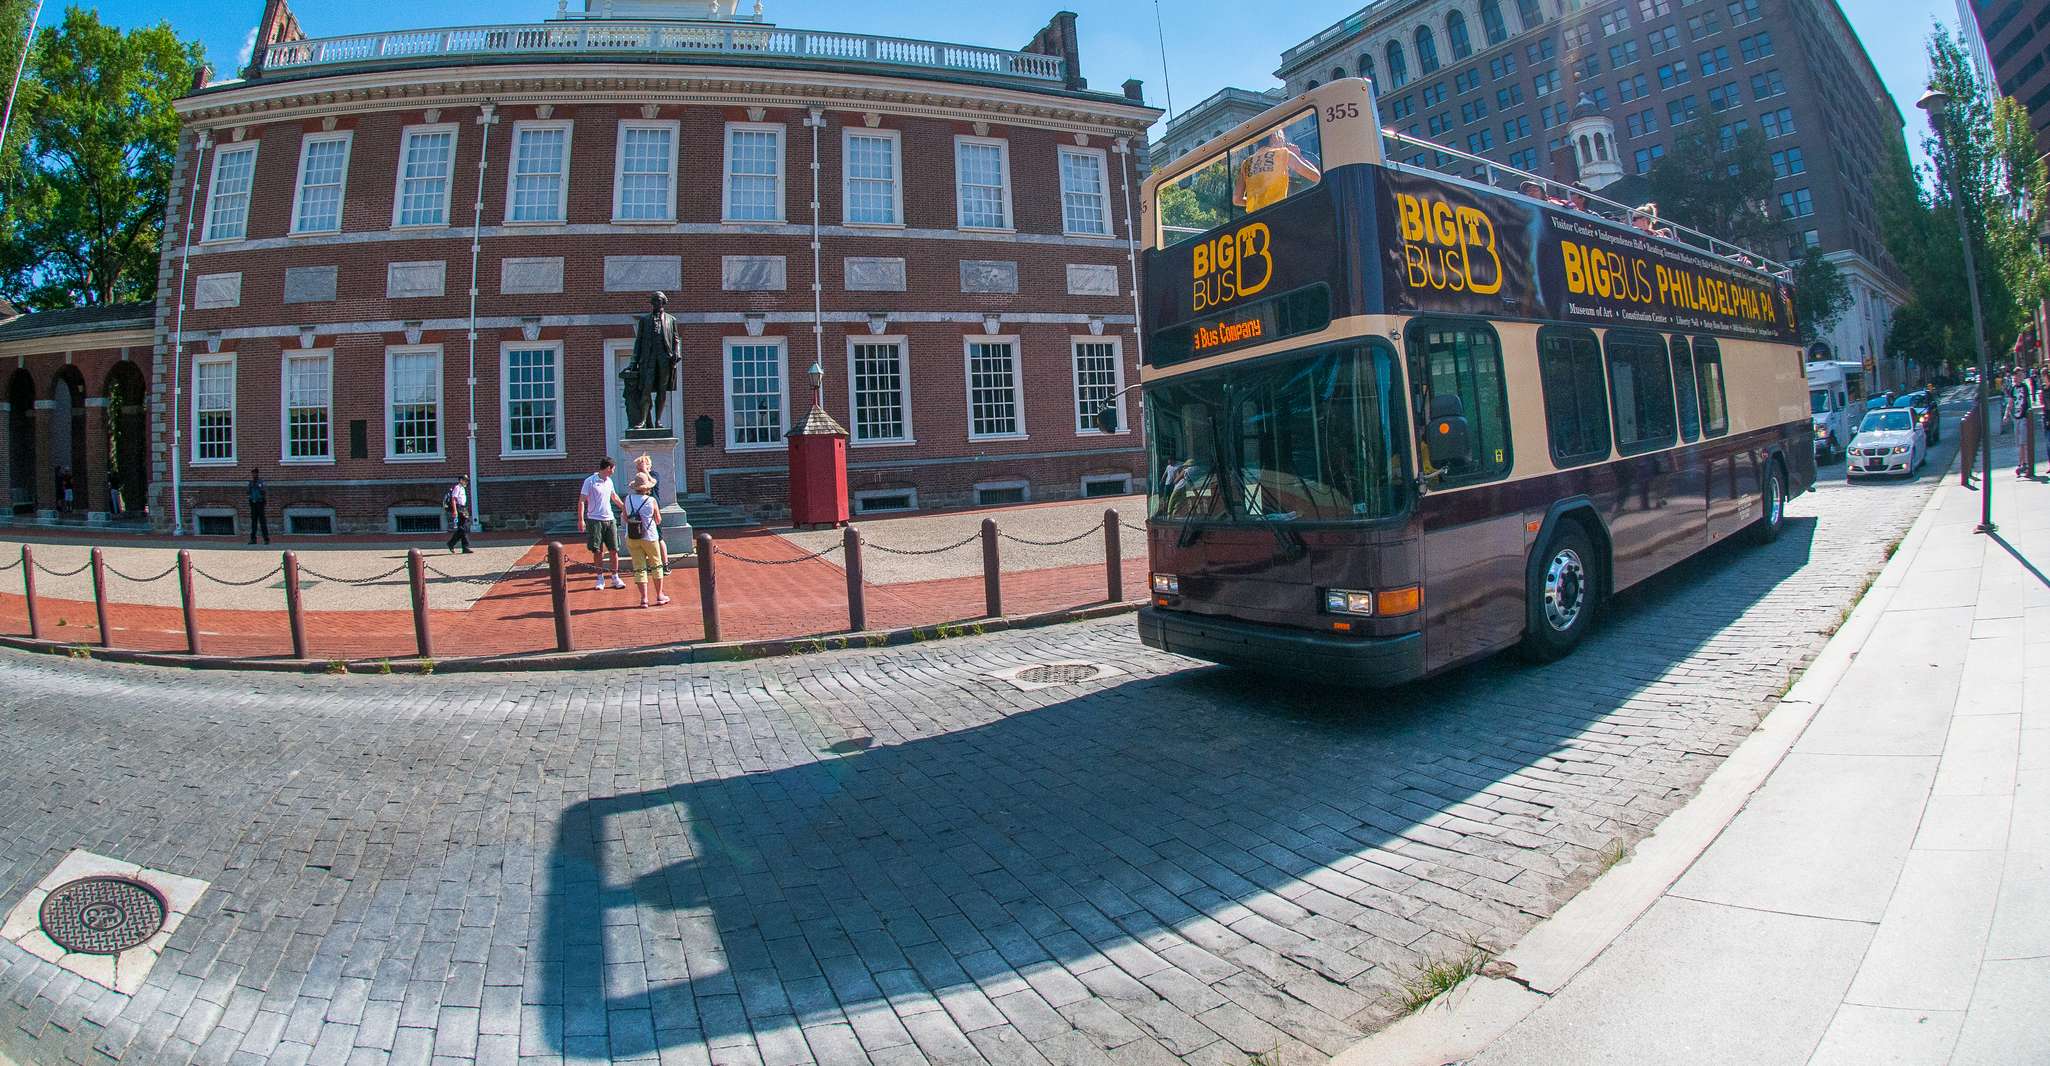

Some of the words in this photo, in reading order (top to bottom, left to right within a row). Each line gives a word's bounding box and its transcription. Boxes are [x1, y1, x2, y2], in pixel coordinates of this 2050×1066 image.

[1325, 103, 1360, 123] 355
[1397, 192, 1456, 247] BIG
[1551, 216, 1573, 232] Visitor
[1573, 222, 1594, 237] Center
[1598, 229, 1633, 247] Independence
[1193, 234, 1234, 279] BIG
[1405, 244, 1464, 291] BUS
[1193, 270, 1235, 311] BUS
[1656, 264, 1760, 321] PHILADELPHIA
[1760, 290, 1776, 323] PA
[1568, 302, 1595, 316] Museum
[1595, 306, 1602, 317] of
[1603, 307, 1613, 318] Art
[1621, 308, 1652, 321] Constitution
[1651, 312, 1667, 323] Center
[1200, 327, 1218, 348] Bus
[1219, 319, 1261, 343] Company
